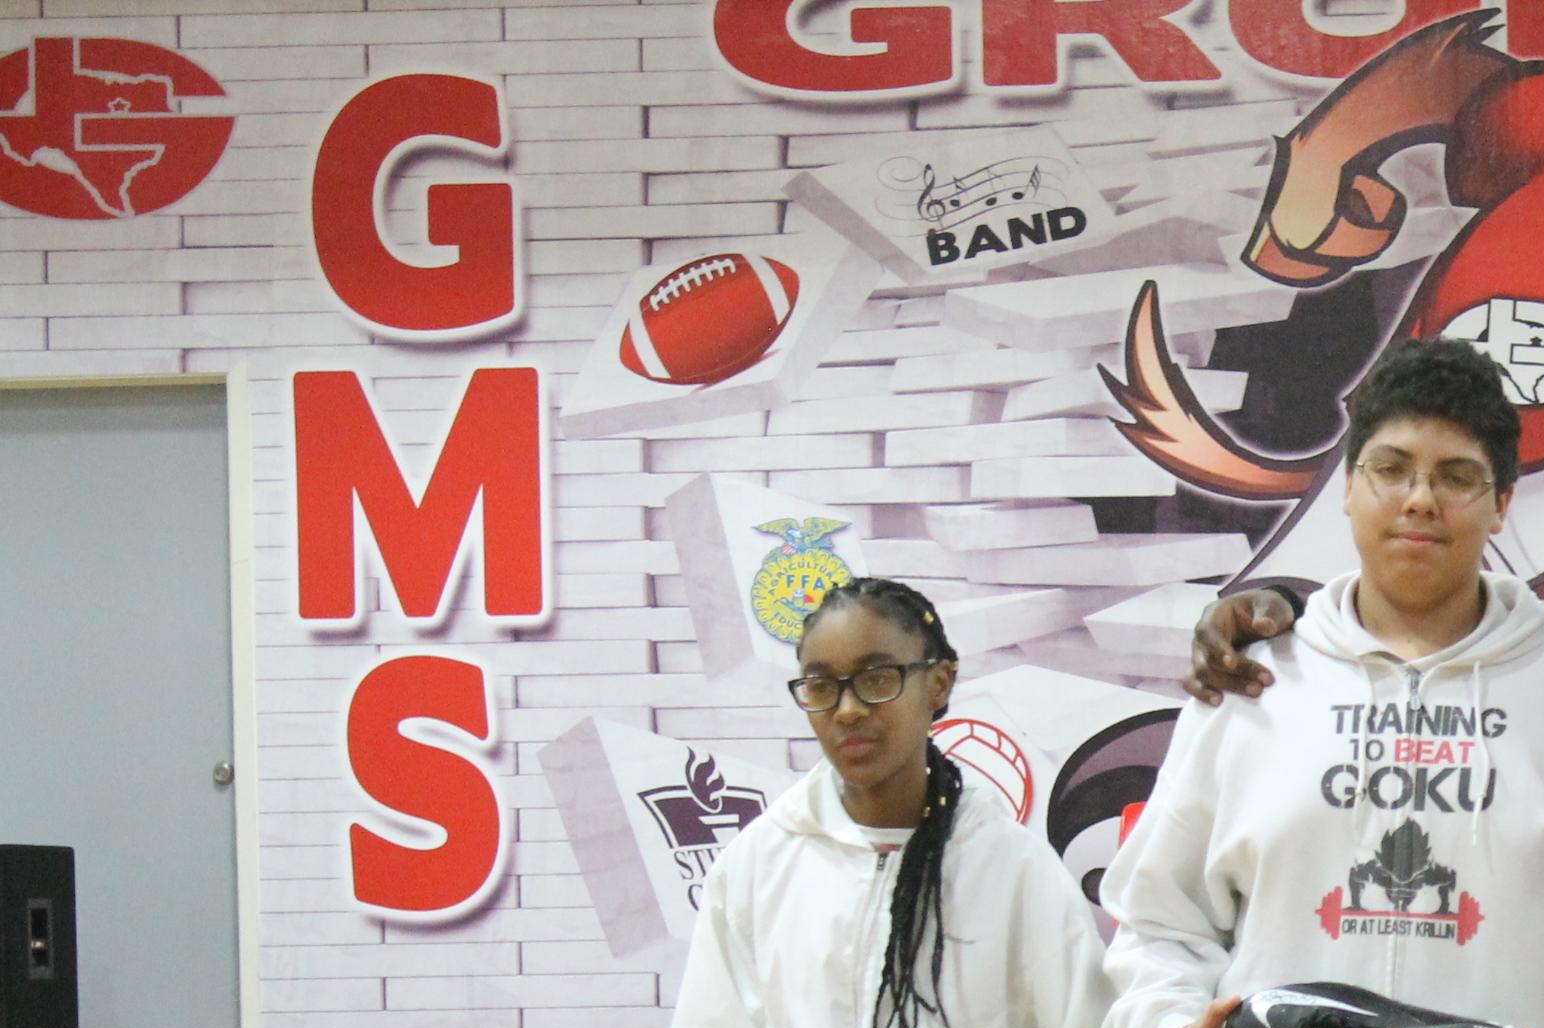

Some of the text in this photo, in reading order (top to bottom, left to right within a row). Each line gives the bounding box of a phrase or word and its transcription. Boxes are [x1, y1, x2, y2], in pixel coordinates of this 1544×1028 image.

[926, 206, 1088, 266] BAND
[786, 573, 827, 591] FFA
[1330, 702, 1508, 739] TRAINING
[1394, 738, 1476, 765] BEAT
[1320, 764, 1498, 813] GOKU
[1341, 918, 1358, 935] OR
[1359, 918, 1376, 935] AT
[1377, 919, 1413, 936] LEAST
